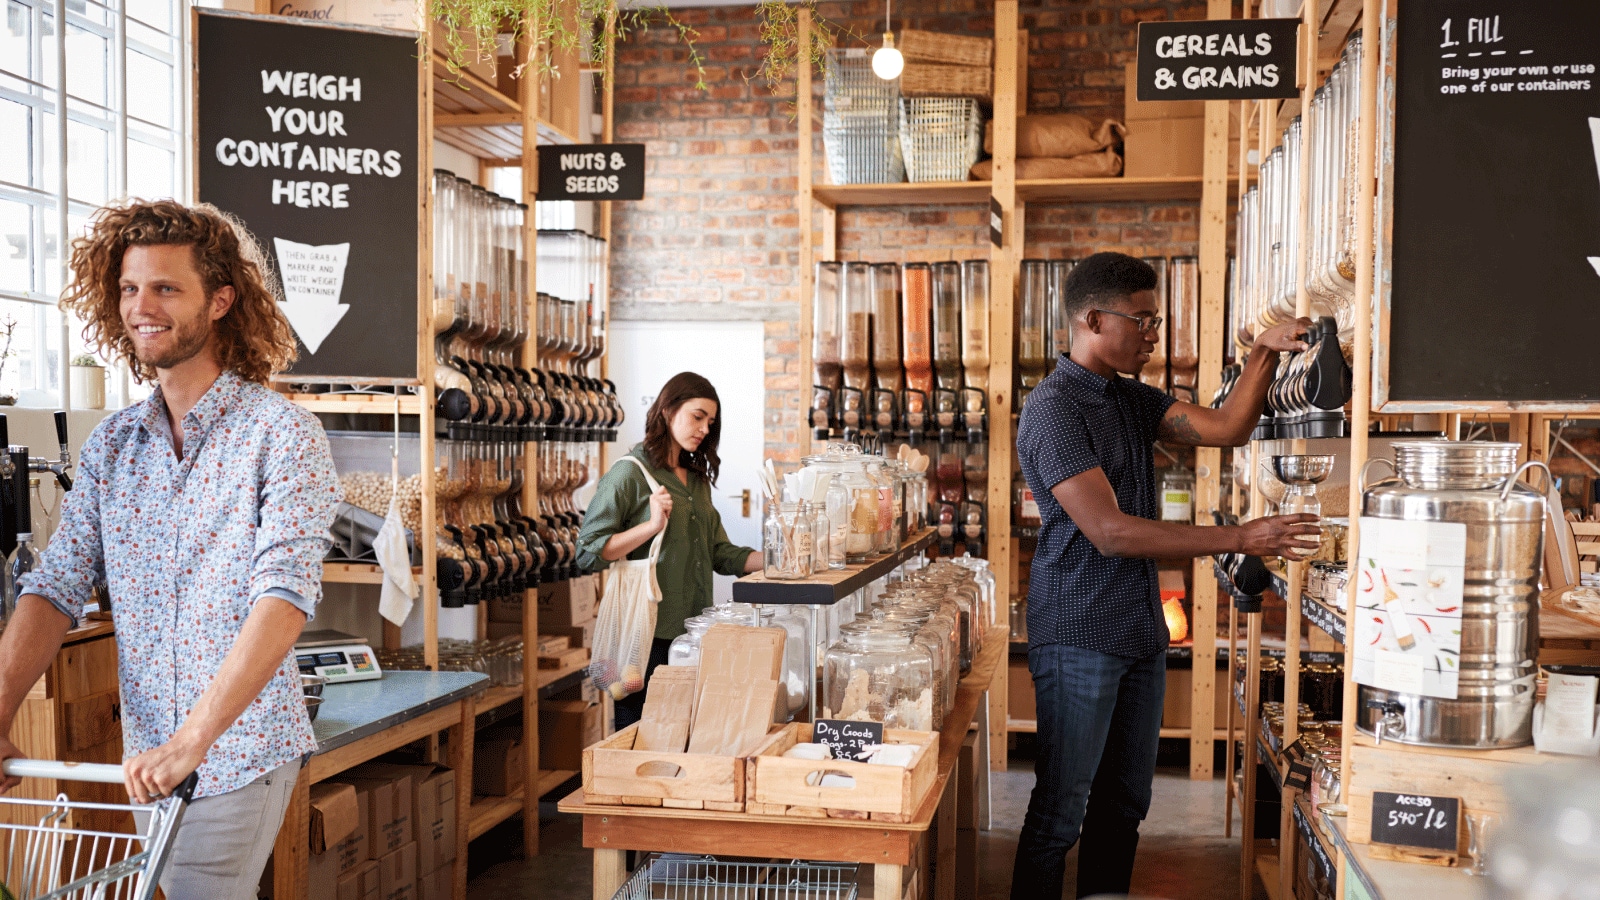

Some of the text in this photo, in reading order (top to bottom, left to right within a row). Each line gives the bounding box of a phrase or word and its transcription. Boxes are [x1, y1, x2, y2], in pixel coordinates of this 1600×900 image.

[1439, 15, 1504, 49] 1. FILL
[1155, 32, 1272, 59] CEREALS
[1154, 64, 1280, 90] & GRAINS
[1441, 63, 1596, 81] Bring your own or use
[260, 69, 362, 102] WEIGH
[1440, 78, 1592, 94] one of our containers
[265, 105, 348, 137] YOUR
[215, 137, 402, 178] CONTAINERS
[560, 151, 626, 171] NUTS &
[271, 178, 350, 209] HERE
[565, 174, 620, 194] SEEDS
[285, 251, 306, 260] THEN
[309, 252, 331, 262] GRAB
[286, 263, 334, 273] MARKER AND
[286, 275, 337, 286] WRITE WEIGHT
[298, 286, 336, 296] CONTAINER
[816, 722, 874, 741] Dry Goods
[849, 739, 857, 748] 2
